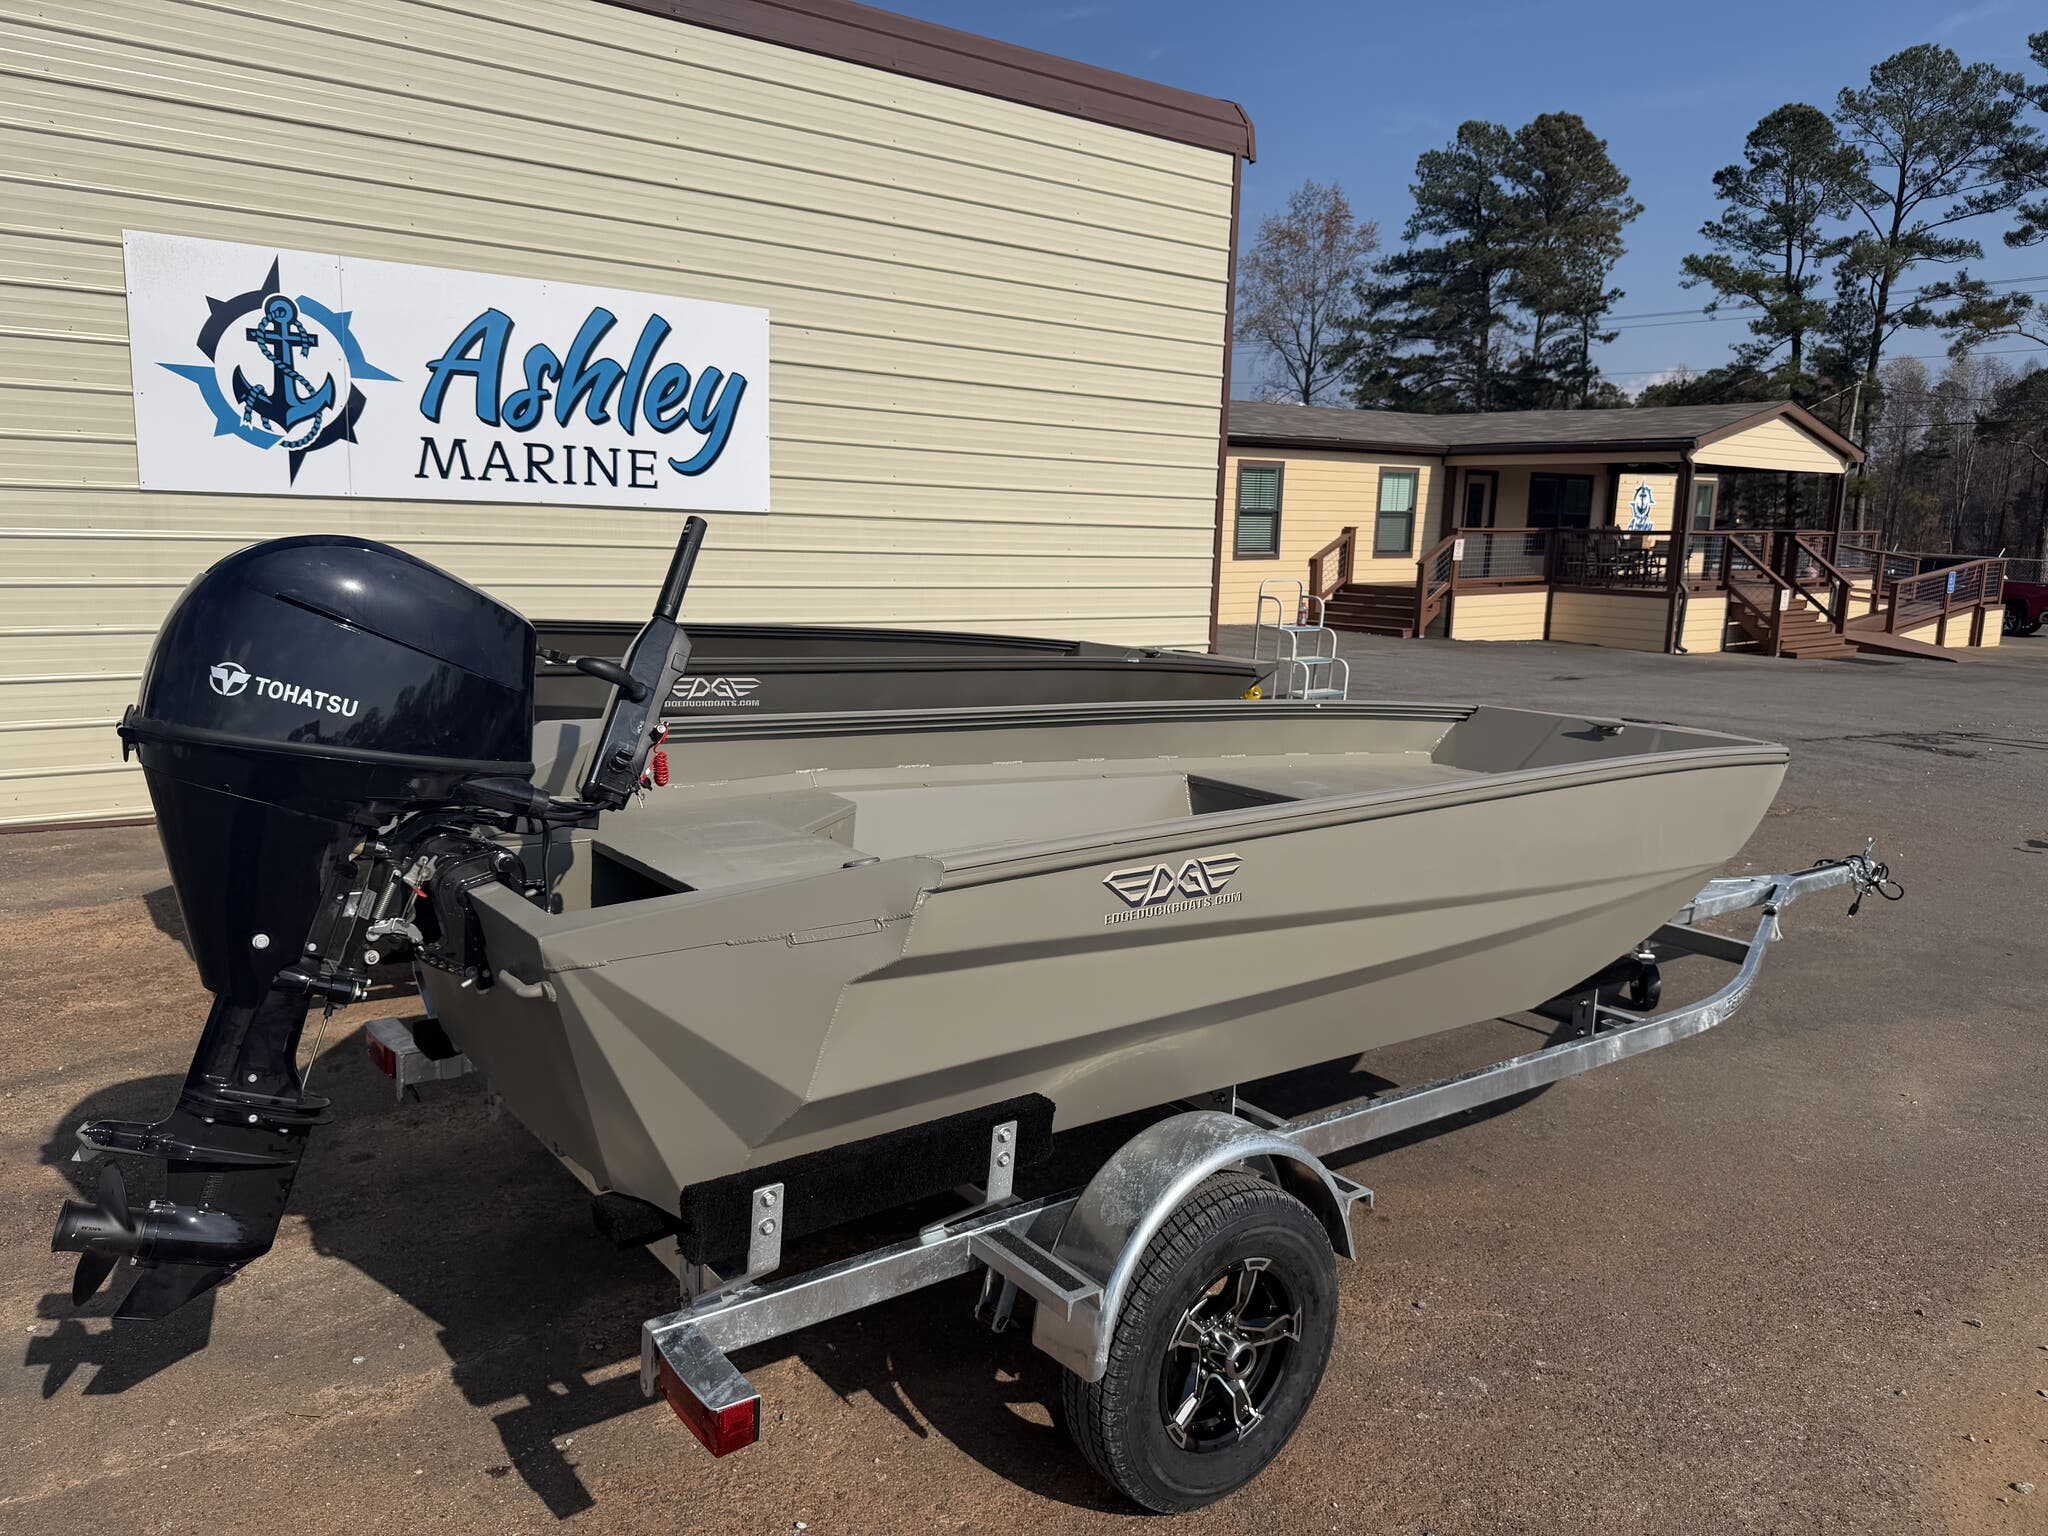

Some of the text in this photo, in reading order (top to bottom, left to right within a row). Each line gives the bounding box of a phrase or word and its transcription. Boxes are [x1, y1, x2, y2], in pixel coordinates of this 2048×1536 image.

[420, 306, 748, 476] Ashley
[414, 436, 659, 489] MARINE
[255, 676, 359, 717] TOHATSU
[664, 699, 760, 707] DGEDUCKBOATS.COM
[1102, 852, 1244, 909] EDGE
[1104, 891, 1242, 926] EDGEDUCKBOATS.COM
